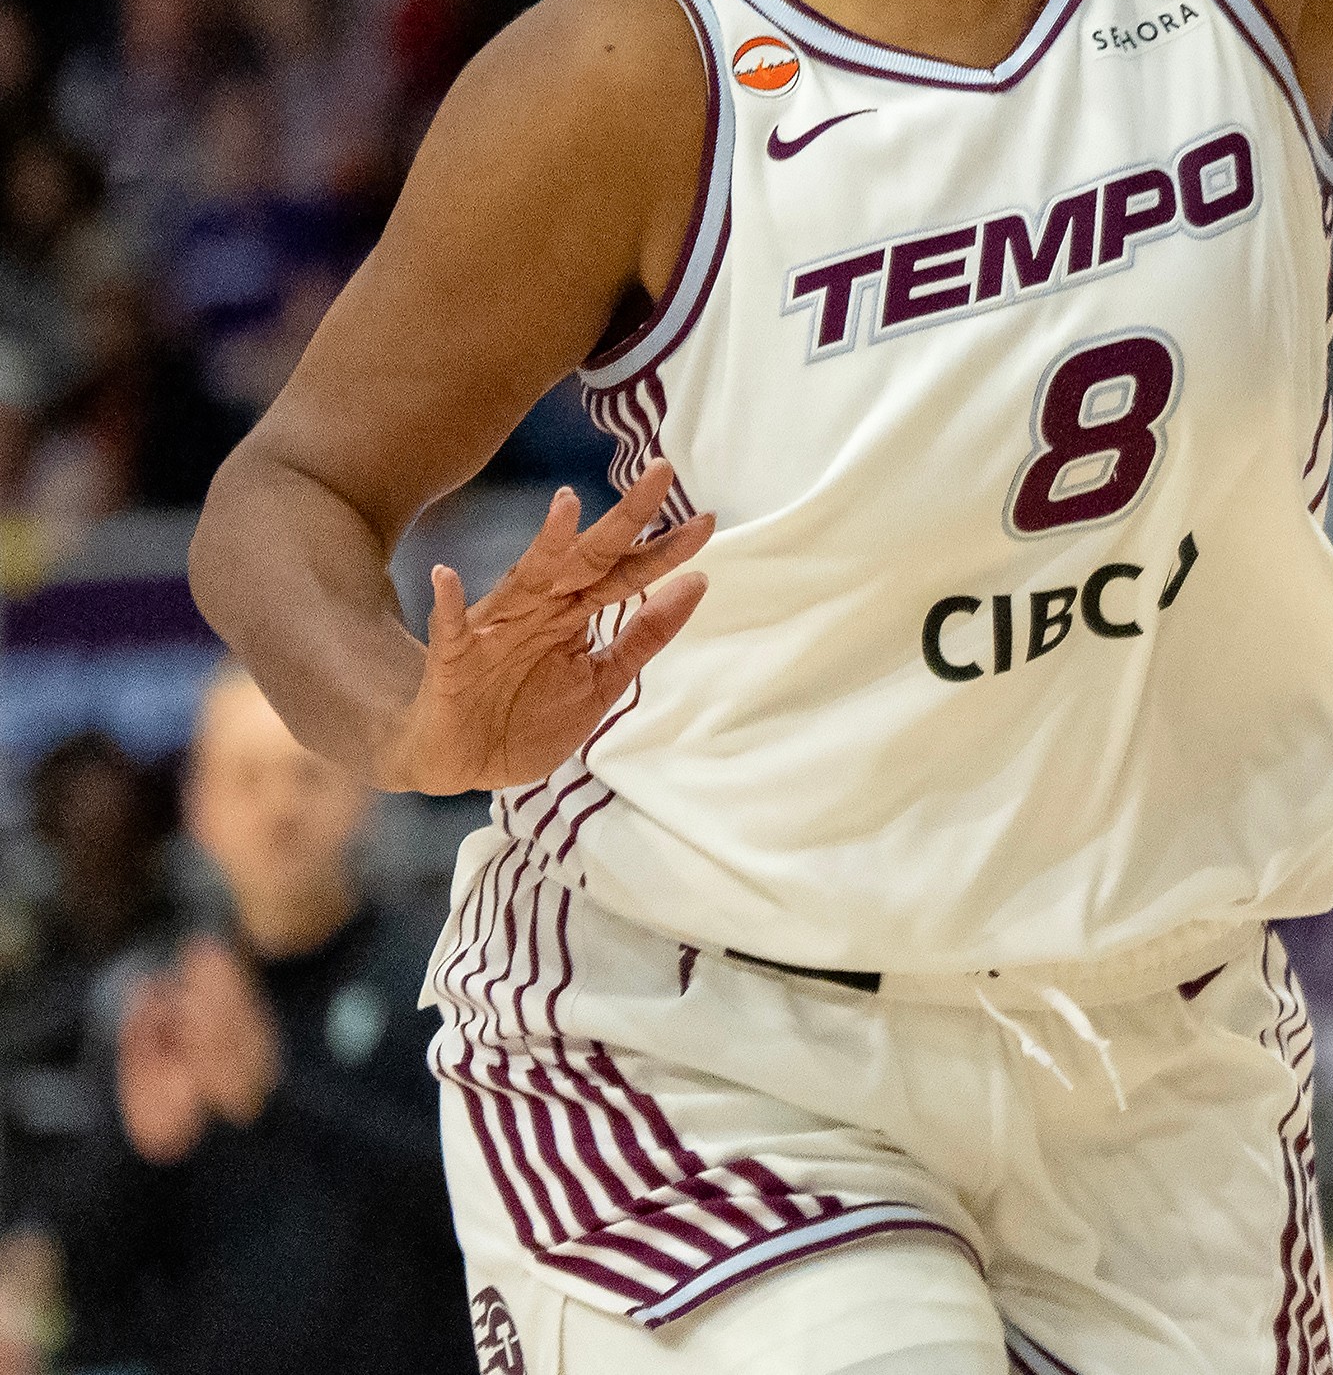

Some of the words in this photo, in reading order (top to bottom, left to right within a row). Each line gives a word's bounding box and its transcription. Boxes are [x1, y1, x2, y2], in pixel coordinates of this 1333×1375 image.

[785, 127, 1260, 360] TEMPO
[1006, 331, 1180, 537] 8
[920, 561, 1145, 683] CIBC
